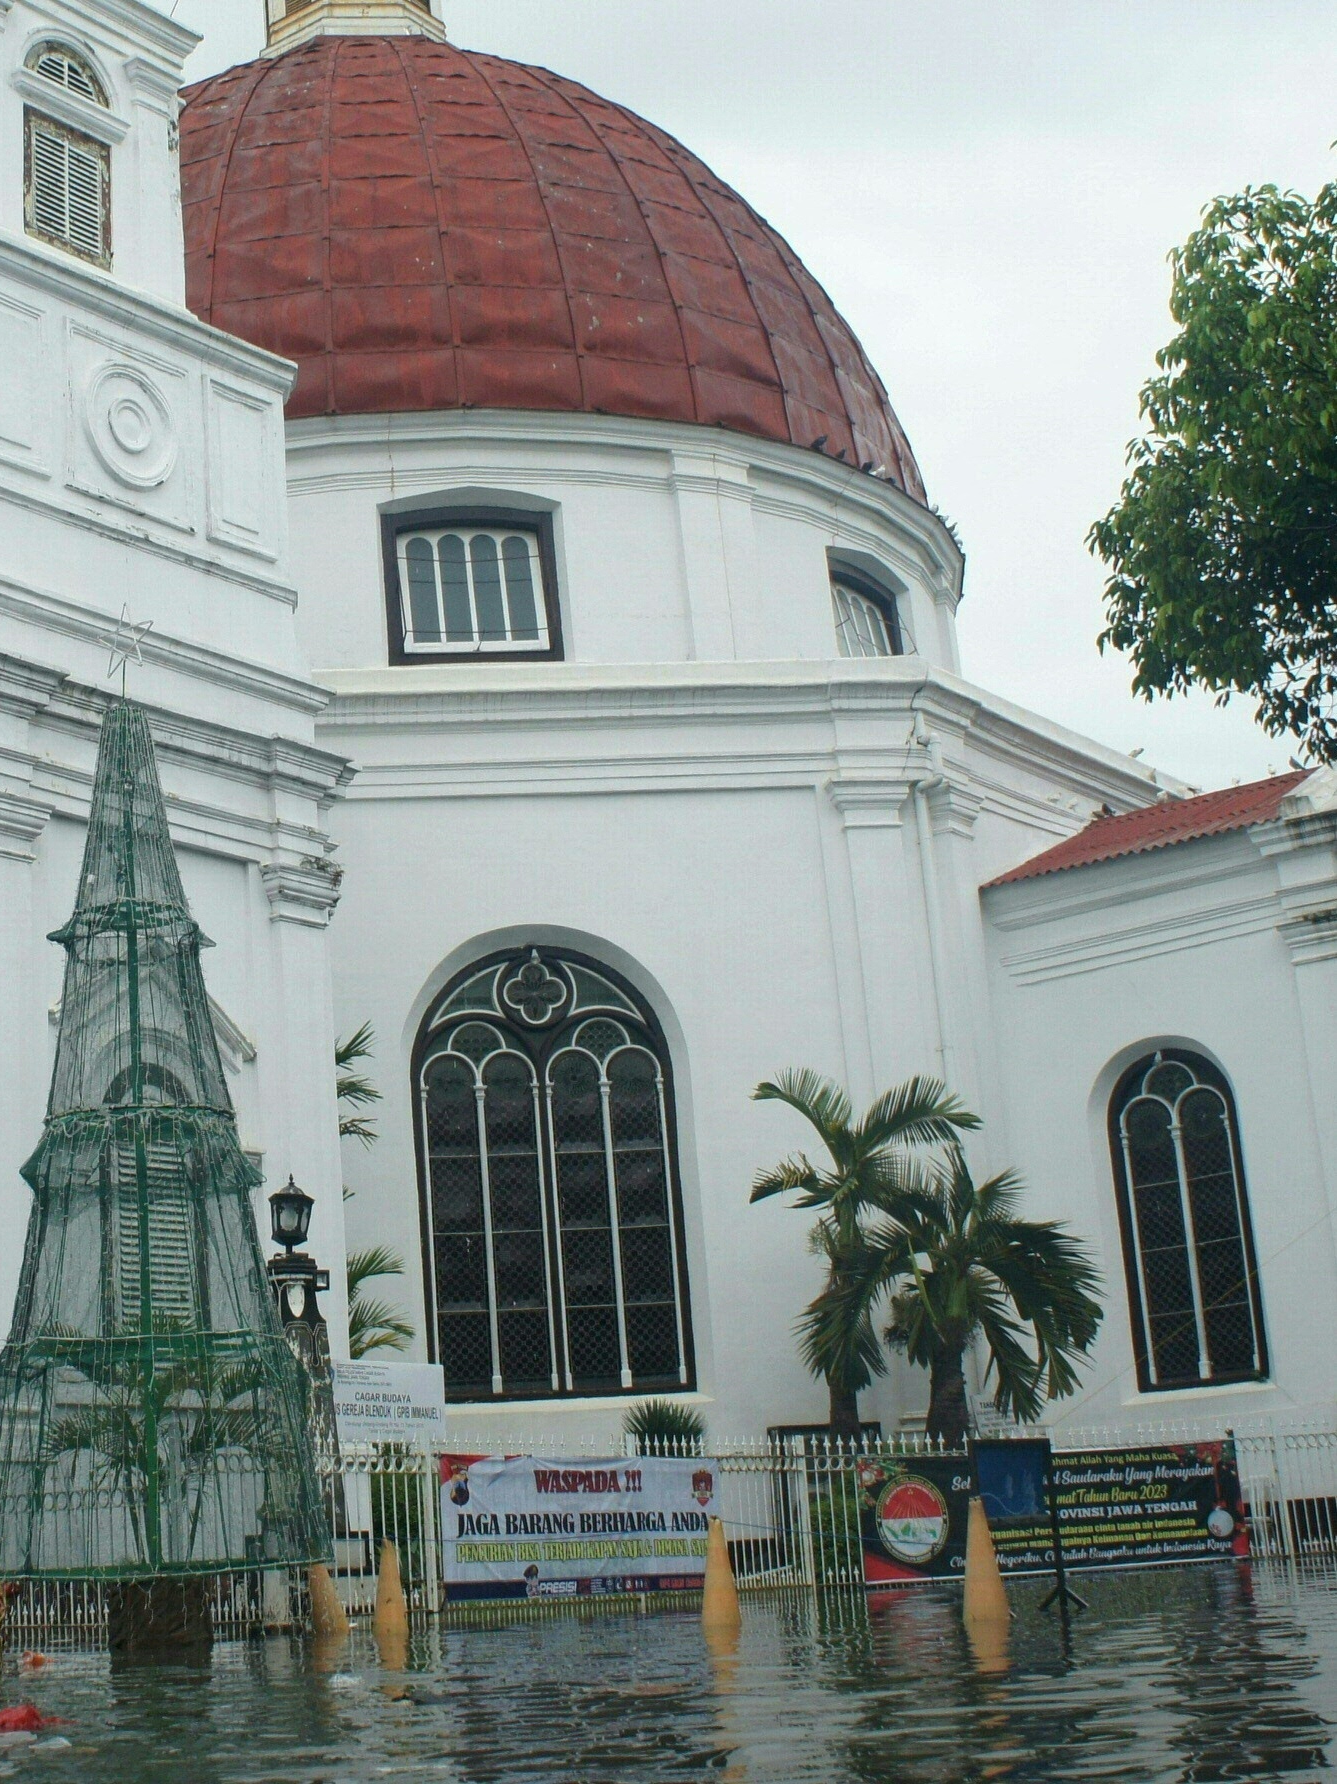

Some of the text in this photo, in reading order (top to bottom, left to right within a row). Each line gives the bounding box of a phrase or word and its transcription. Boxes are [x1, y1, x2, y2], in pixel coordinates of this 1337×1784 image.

[355, 1392, 411, 1404] CAGAR BUDAYA
[342, 1403, 364, 1417] GEREJA
[365, 1404, 392, 1418] BLENDUK
[1051, 1455, 1078, 1466] ahmat
[1080, 1454, 1101, 1465] Allah
[1104, 1453, 1124, 1465] Yang
[1126, 1452, 1149, 1463] Maha
[533, 1469, 642, 1494] WASPADA !!!
[1062, 1468, 1123, 1485] Saudaraku
[1124, 1467, 1153, 1485] Yang
[1155, 1463, 1215, 1482] Merayakan
[1076, 1487, 1109, 1503] Tahun
[1112, 1486, 1138, 1501] Baru
[1140, 1484, 1168, 1500] 2023
[1056, 1500, 1198, 1520] OVINSI JAWA TENGAH
[457, 1511, 709, 1538] JAGA BARANG BERHARGA ANDA
[517, 1543, 541, 1561] BISA
[1163, 1540, 1206, 1553] Indonesia
[1207, 1537, 1233, 1552] Raya
[539, 1580, 578, 1596] PRESISI
